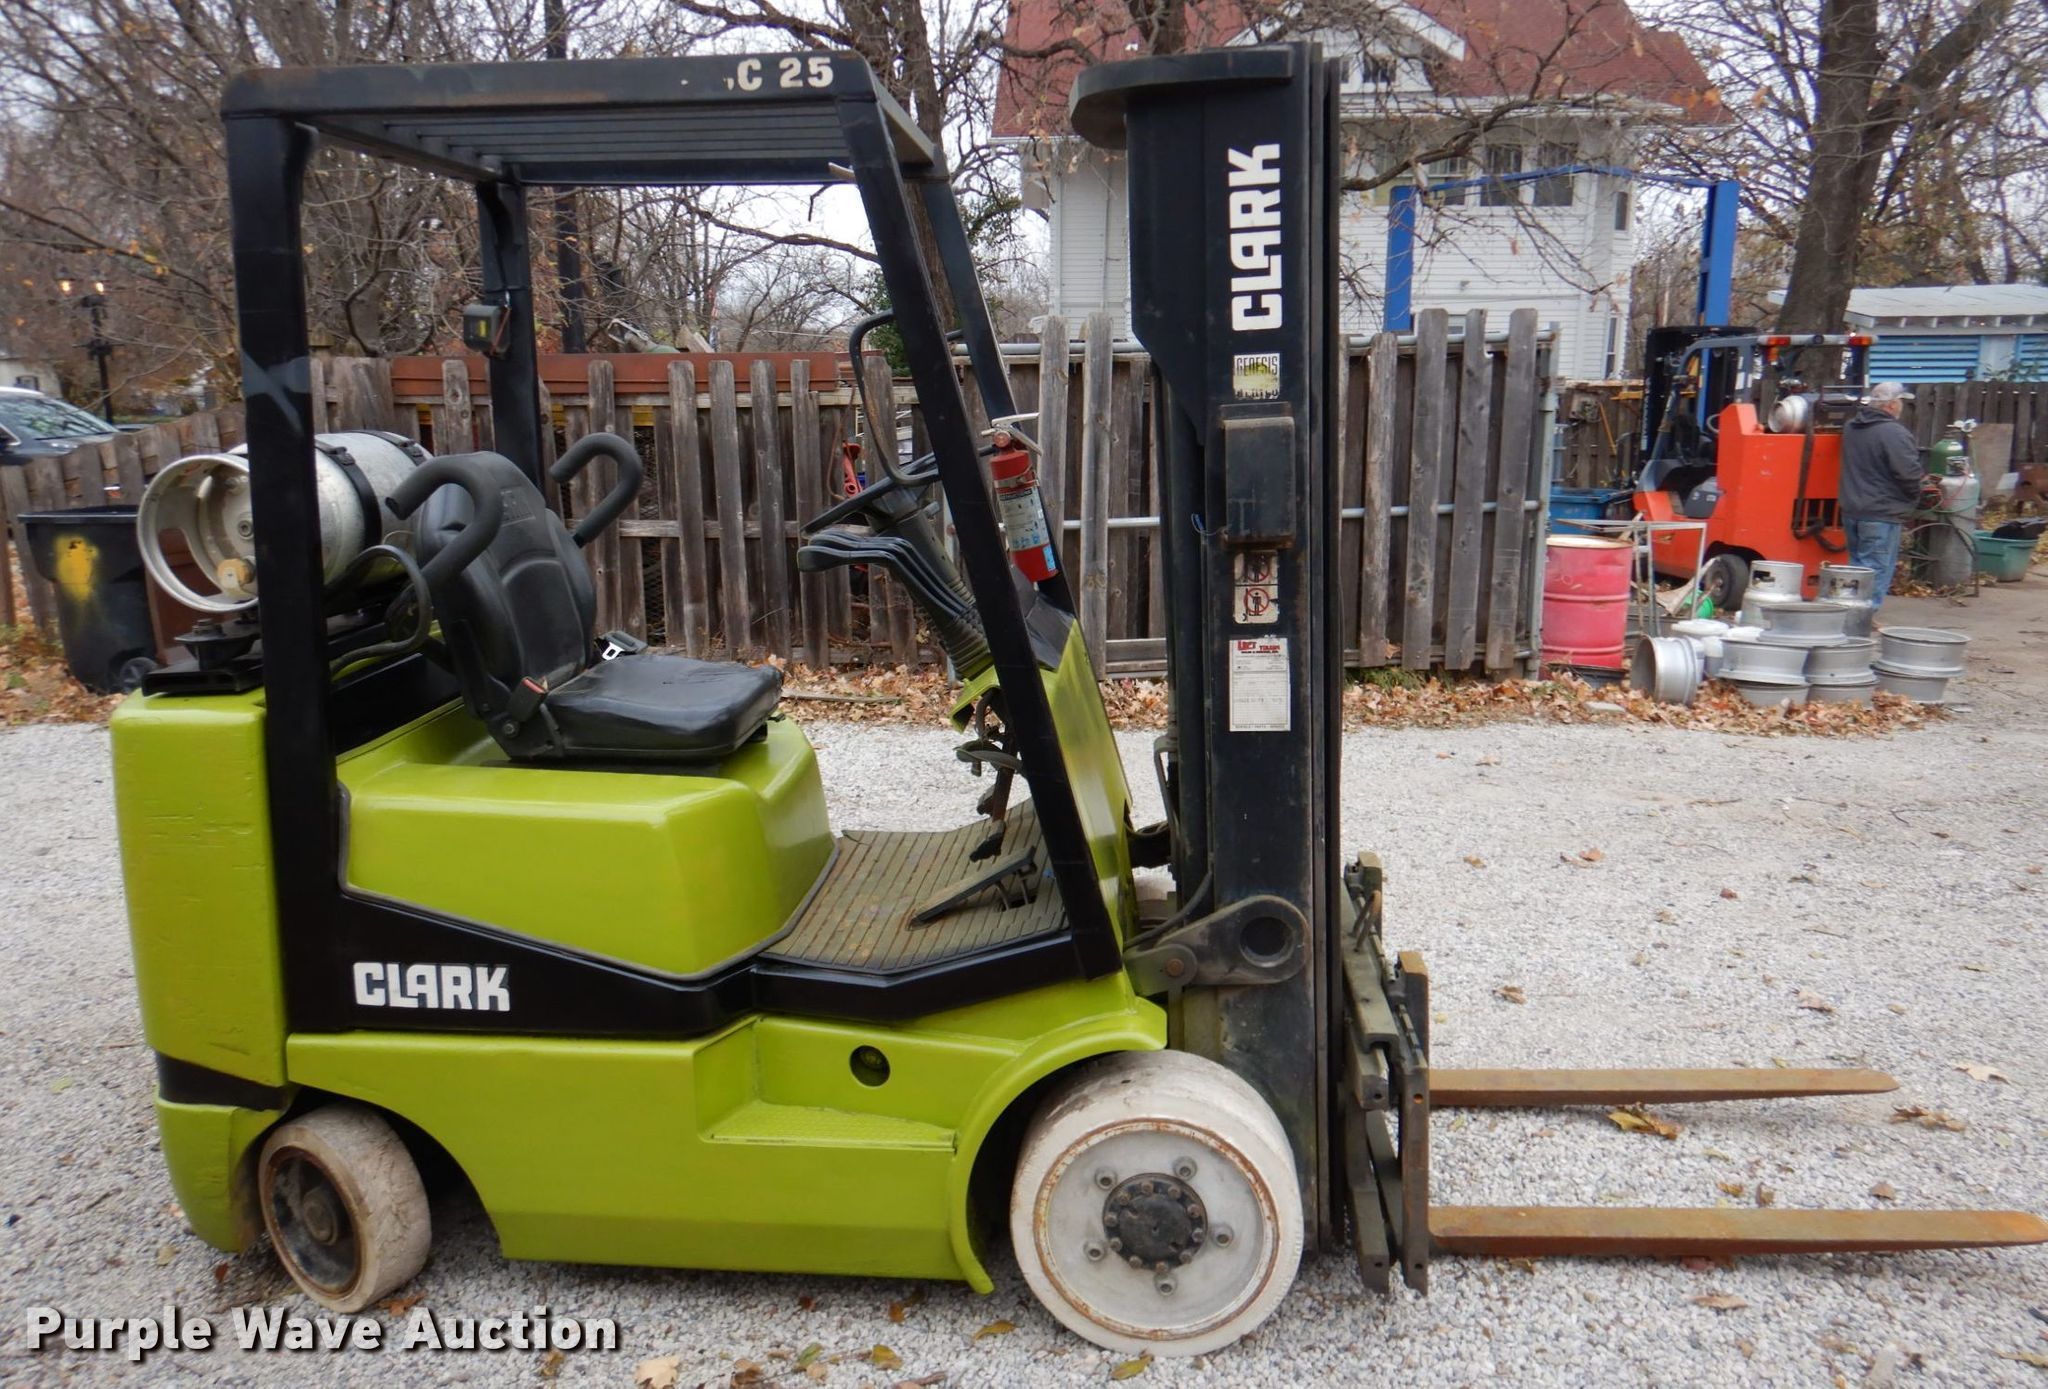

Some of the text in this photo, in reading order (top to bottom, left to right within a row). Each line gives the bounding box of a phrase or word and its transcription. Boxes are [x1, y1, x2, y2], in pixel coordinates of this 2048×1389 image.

[778, 56, 834, 89] 25
[1227, 143, 1283, 332] CLARK
[353, 961, 511, 1012] CLARK
